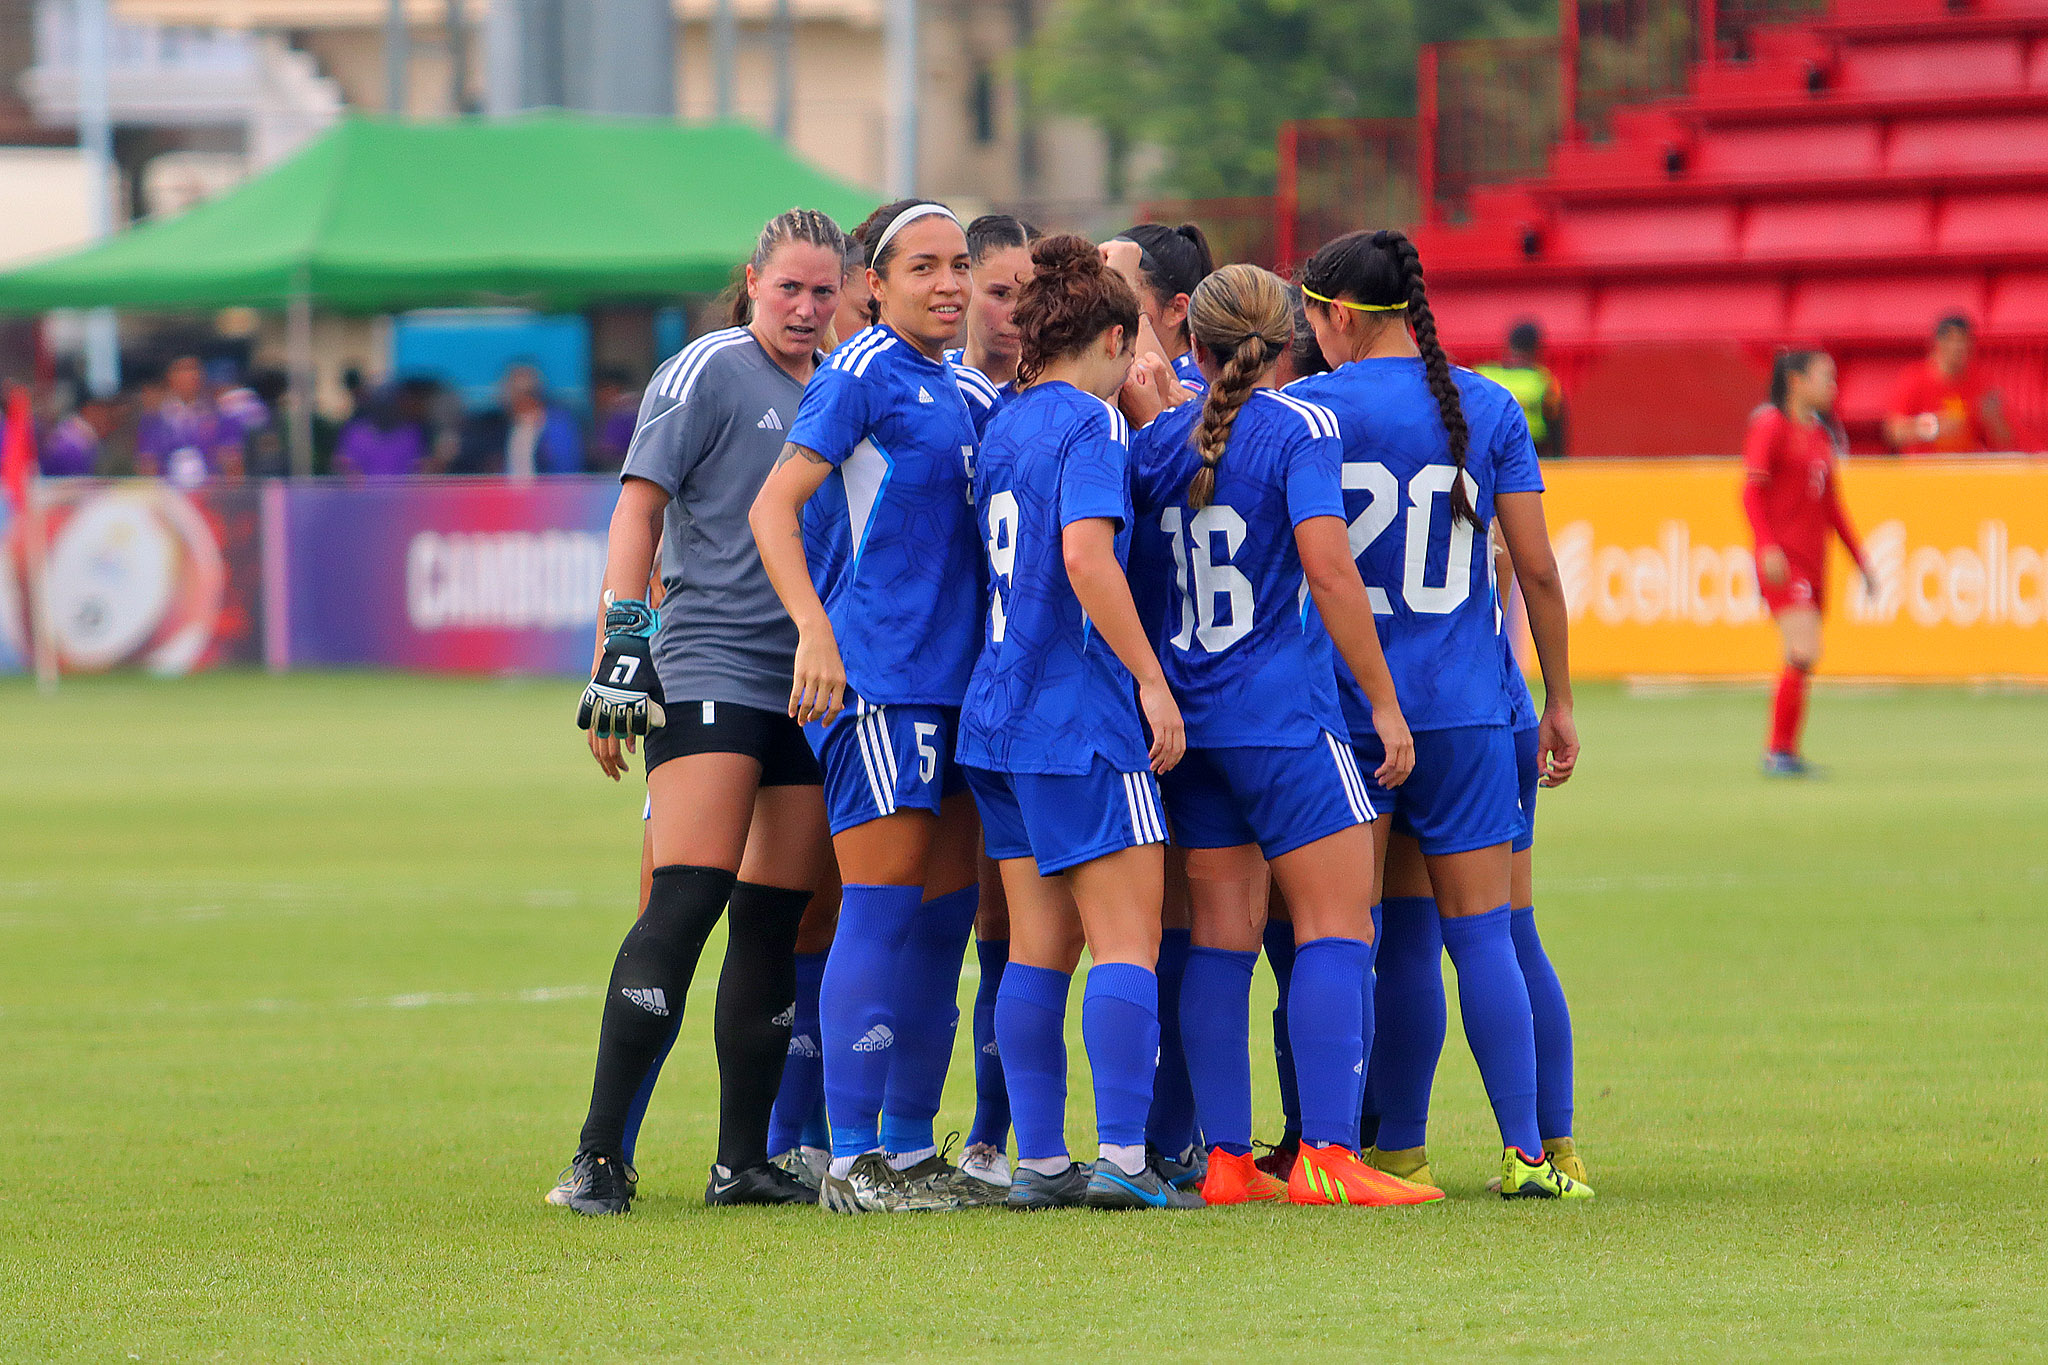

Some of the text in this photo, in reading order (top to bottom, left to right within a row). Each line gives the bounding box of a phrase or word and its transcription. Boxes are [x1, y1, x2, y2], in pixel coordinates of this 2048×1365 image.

[406, 530, 608, 629] CAMBOD
[988, 490, 1018, 642] 9
[1161, 505, 1255, 653] 16
[1342, 461, 1479, 614] 20
[1598, 519, 1770, 626] cellca
[914, 722, 937, 784] 5
[621, 987, 669, 1017] adidas
[787, 1044, 819, 1058] didas
